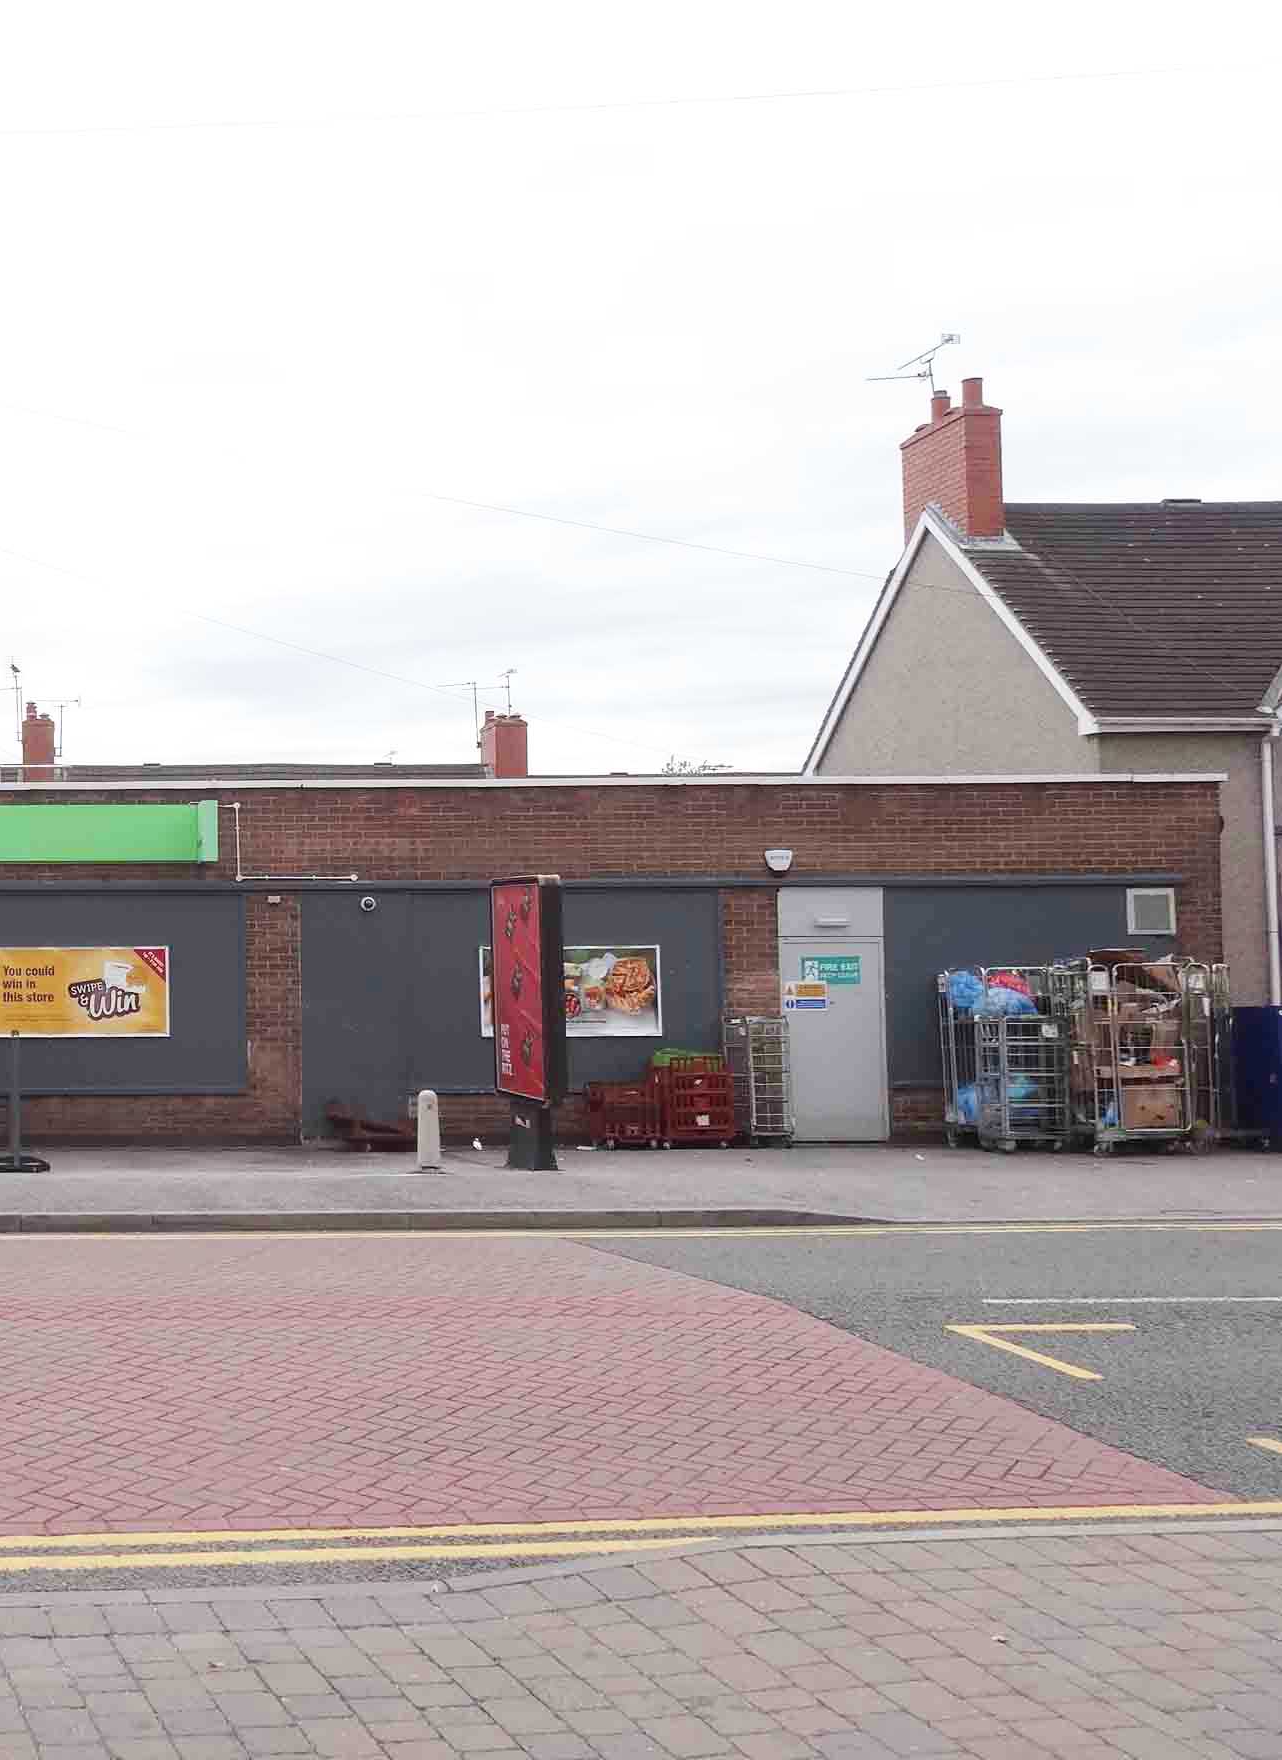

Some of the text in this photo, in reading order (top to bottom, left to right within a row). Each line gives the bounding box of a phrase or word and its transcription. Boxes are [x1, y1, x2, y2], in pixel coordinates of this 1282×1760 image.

[3, 965, 55, 977] You could
[820, 962, 859, 971] FIRE EXIT
[3, 978, 36, 990] win in
[70, 980, 104, 996] SWIPE
[3, 991, 55, 1003] this store
[79, 993, 88, 1006] &
[89, 988, 139, 1018] Win
